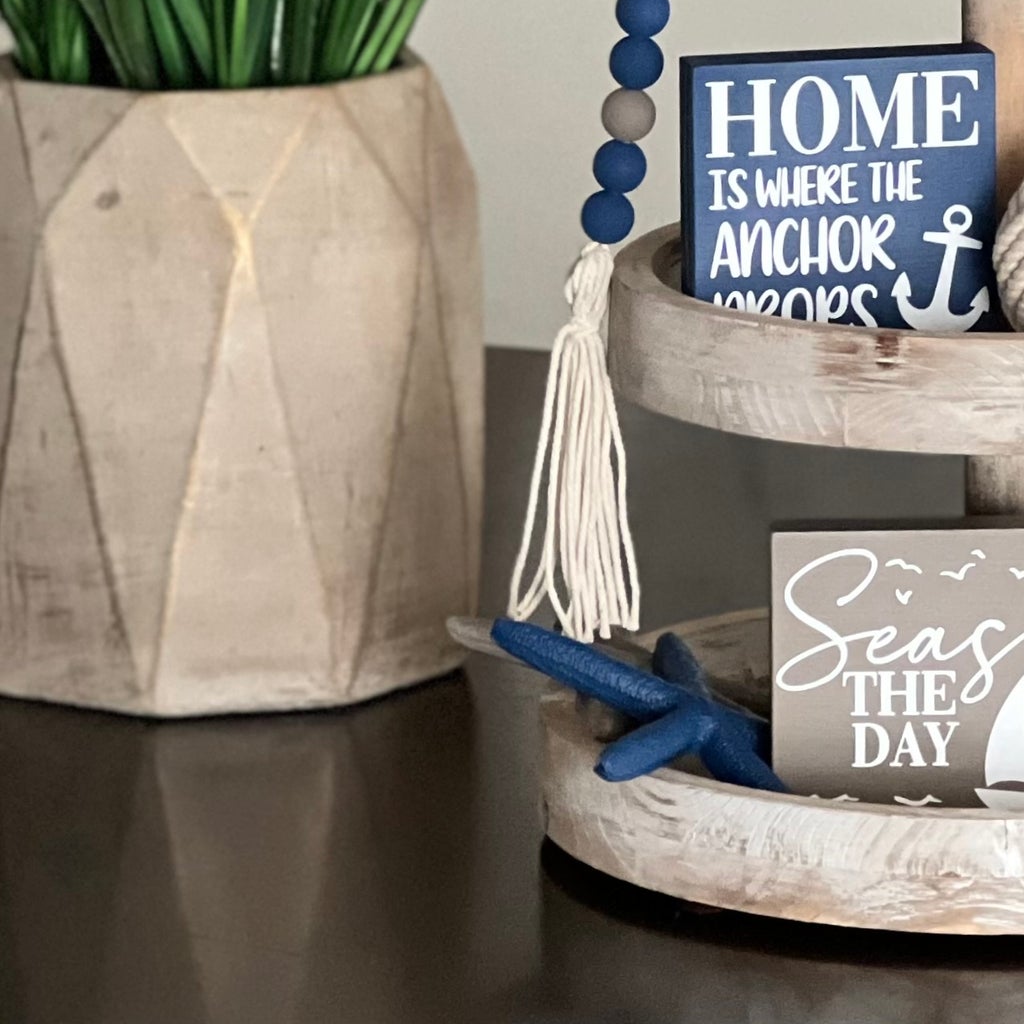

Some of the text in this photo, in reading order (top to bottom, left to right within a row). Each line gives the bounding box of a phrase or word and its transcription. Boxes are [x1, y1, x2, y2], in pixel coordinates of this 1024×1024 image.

[705, 69, 979, 159] HOME
[708, 159, 924, 211] IS WHERE THE
[709, 213, 897, 280] ANCHOR
[713, 283, 880, 328] OPS
[842, 669, 957, 717] THE
[851, 721, 960, 768] DAY
